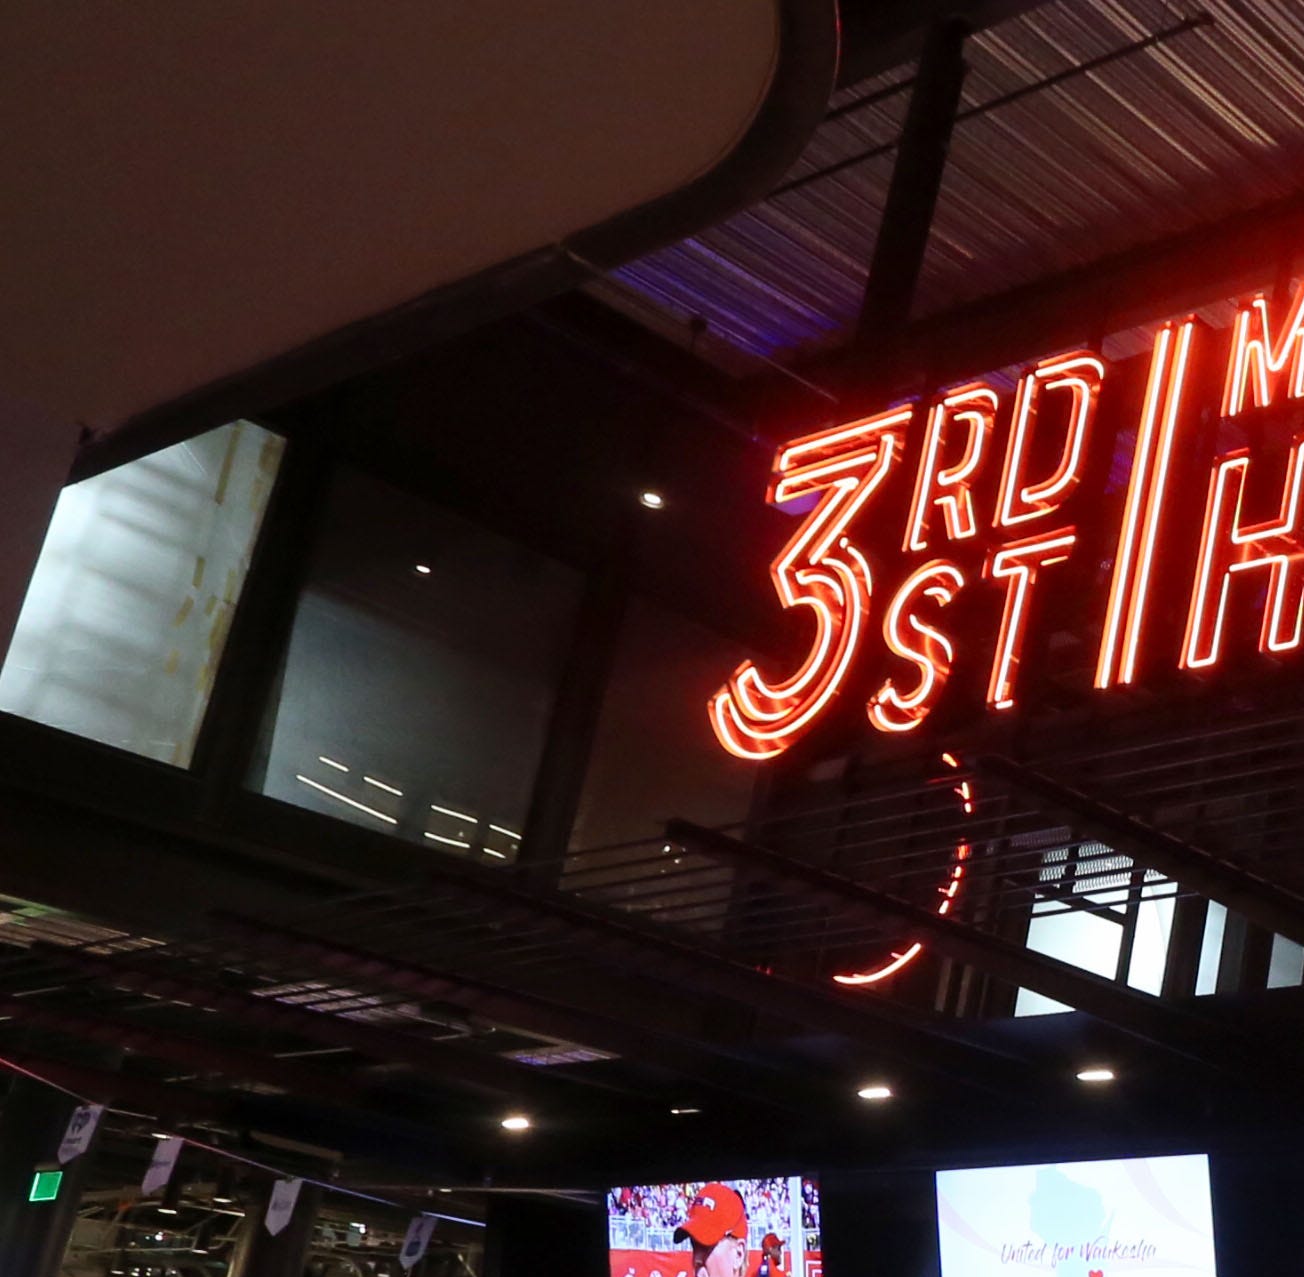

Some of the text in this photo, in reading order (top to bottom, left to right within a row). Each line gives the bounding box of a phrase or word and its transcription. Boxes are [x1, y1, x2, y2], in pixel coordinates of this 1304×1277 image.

[866, 526, 1080, 734] ST
[1001, 1236, 1157, 1269] United for Waukesha
